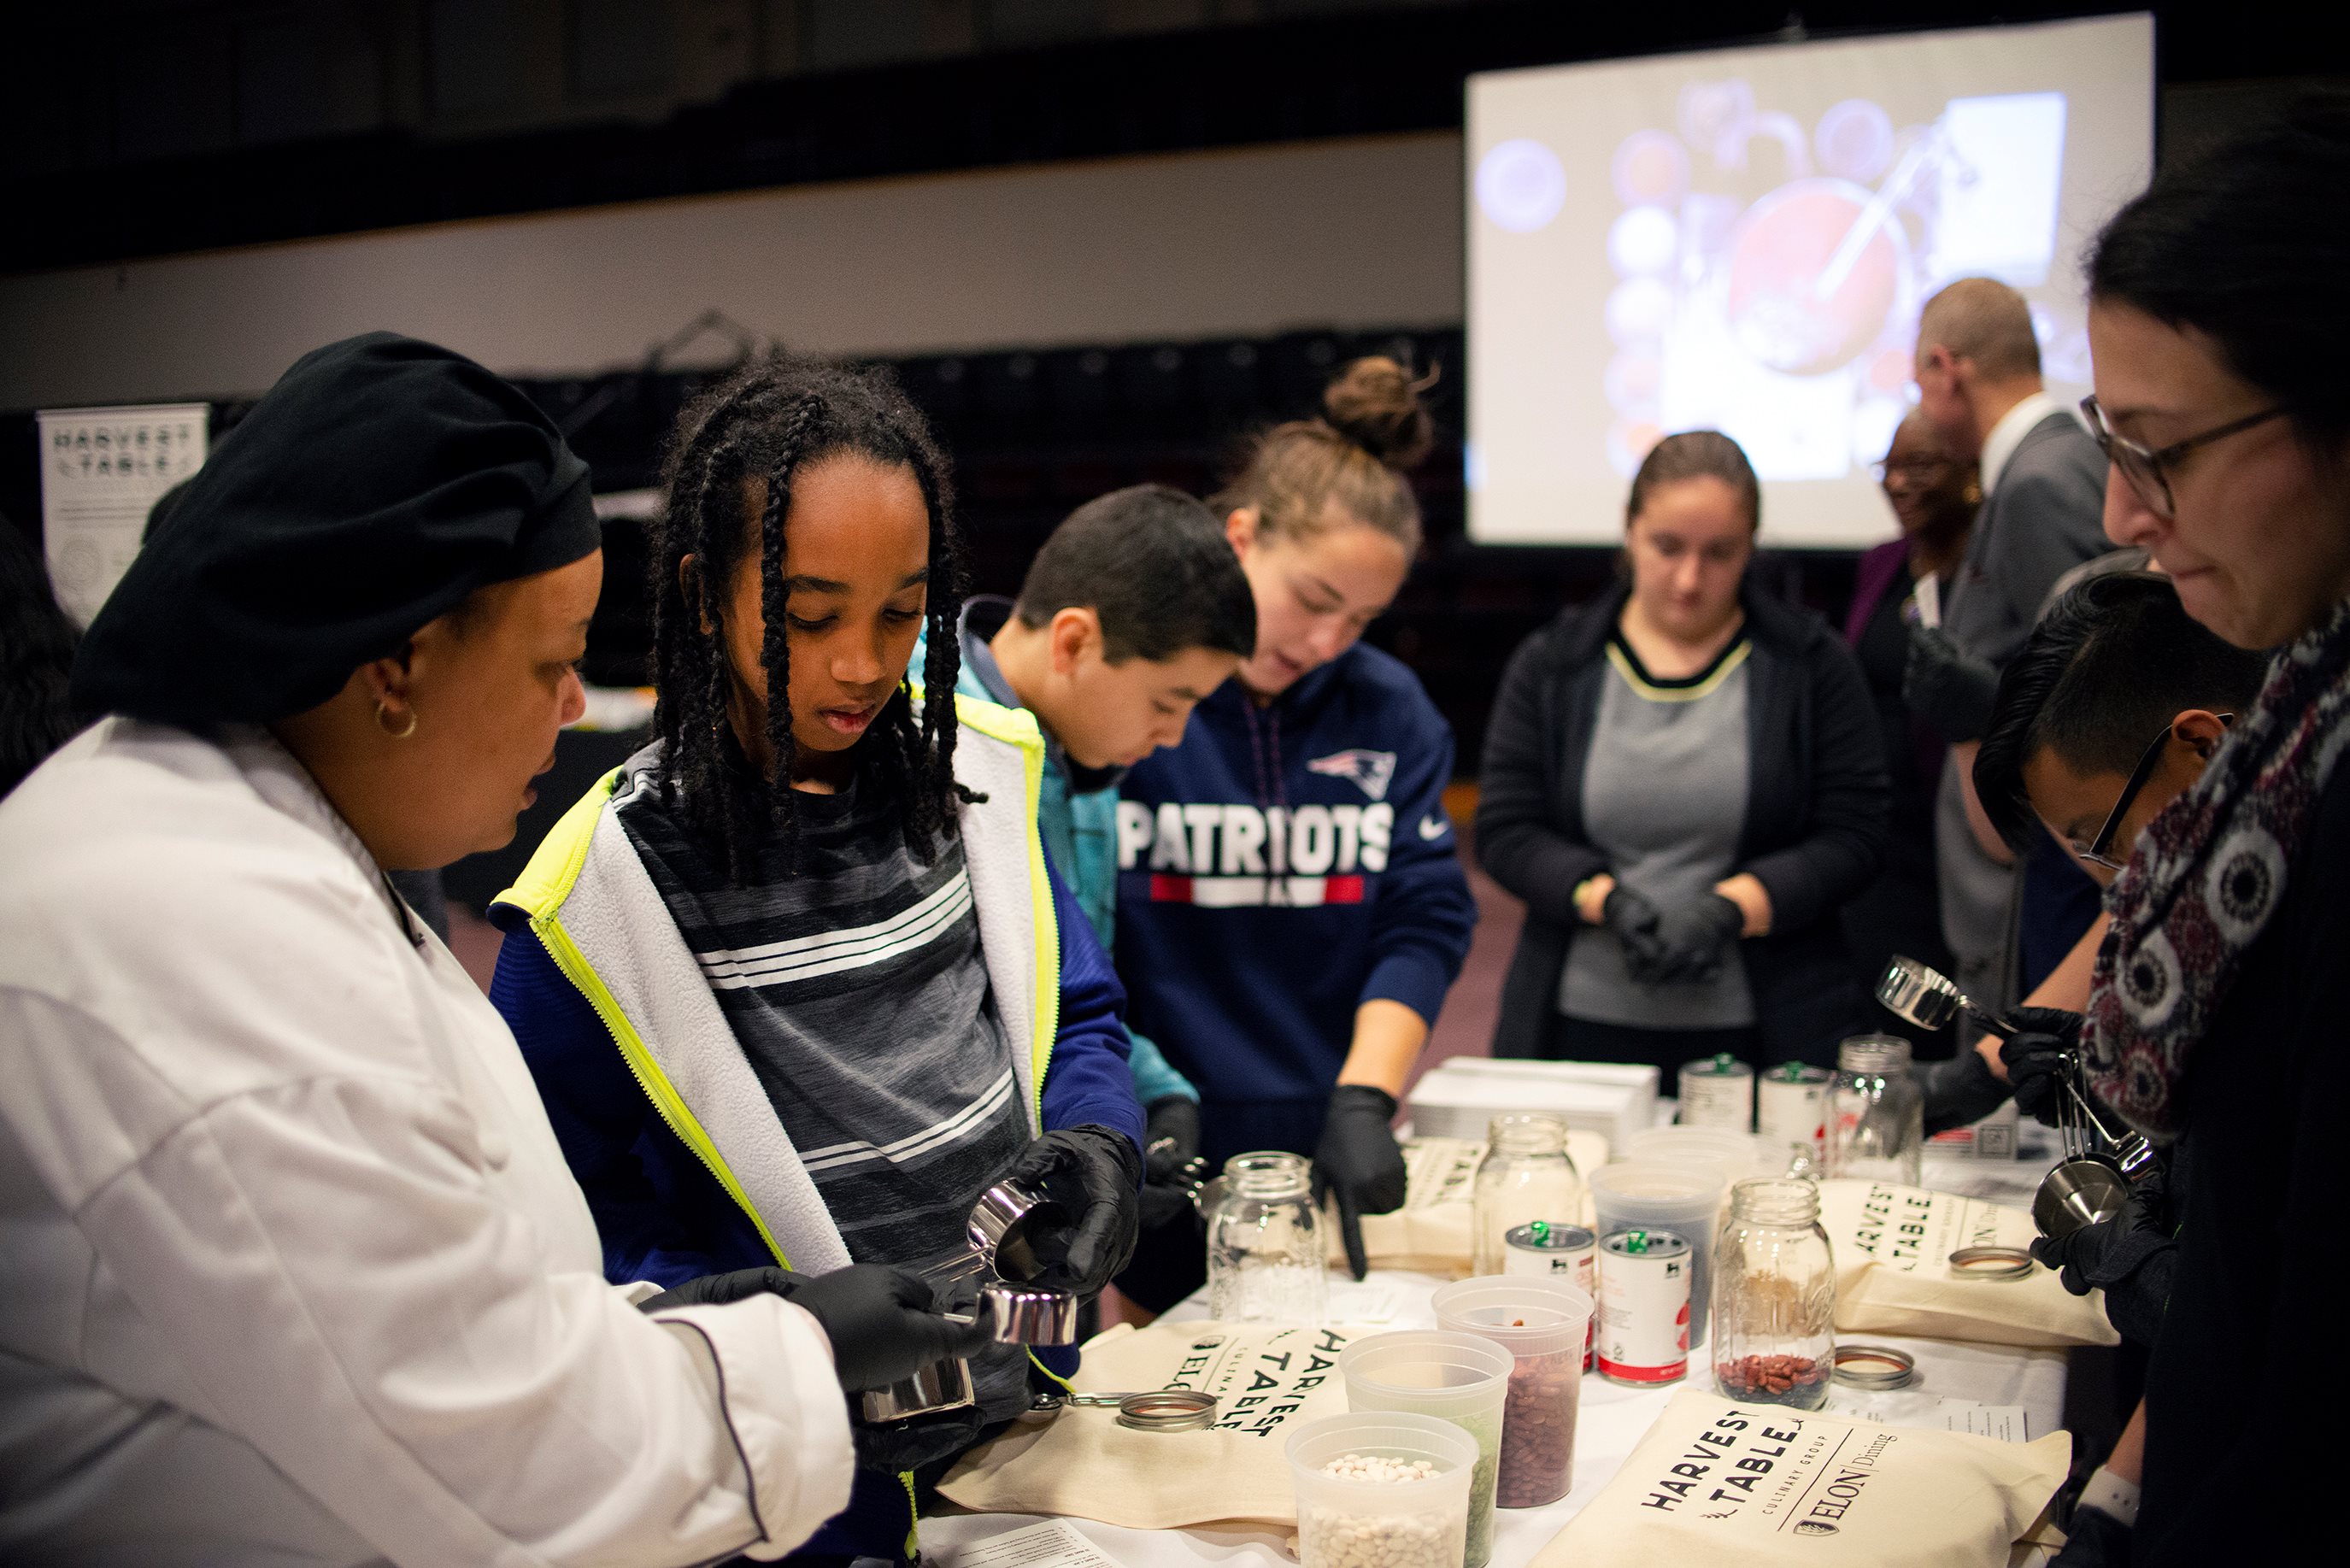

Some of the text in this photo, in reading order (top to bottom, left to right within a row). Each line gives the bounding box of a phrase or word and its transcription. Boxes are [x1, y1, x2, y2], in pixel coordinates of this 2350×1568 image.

[1118, 801, 1394, 873] PATRIOTS
[1853, 1182, 1895, 1256] ARVEST
[1893, 1198, 1930, 1259] TABLE
[1214, 1352, 1291, 1429] TABLE
[1216, 1347, 1248, 1400] CULINAR
[1241, 1329, 1346, 1436] HARVEST
[1641, 1411, 1760, 1512] HARVEST
[1709, 1426, 1798, 1503] TABLE
[1762, 1436, 1828, 1515] CULINARY GROUP
[1809, 1469, 1871, 1521] ELON
[1852, 1434, 1898, 1466] Dining
